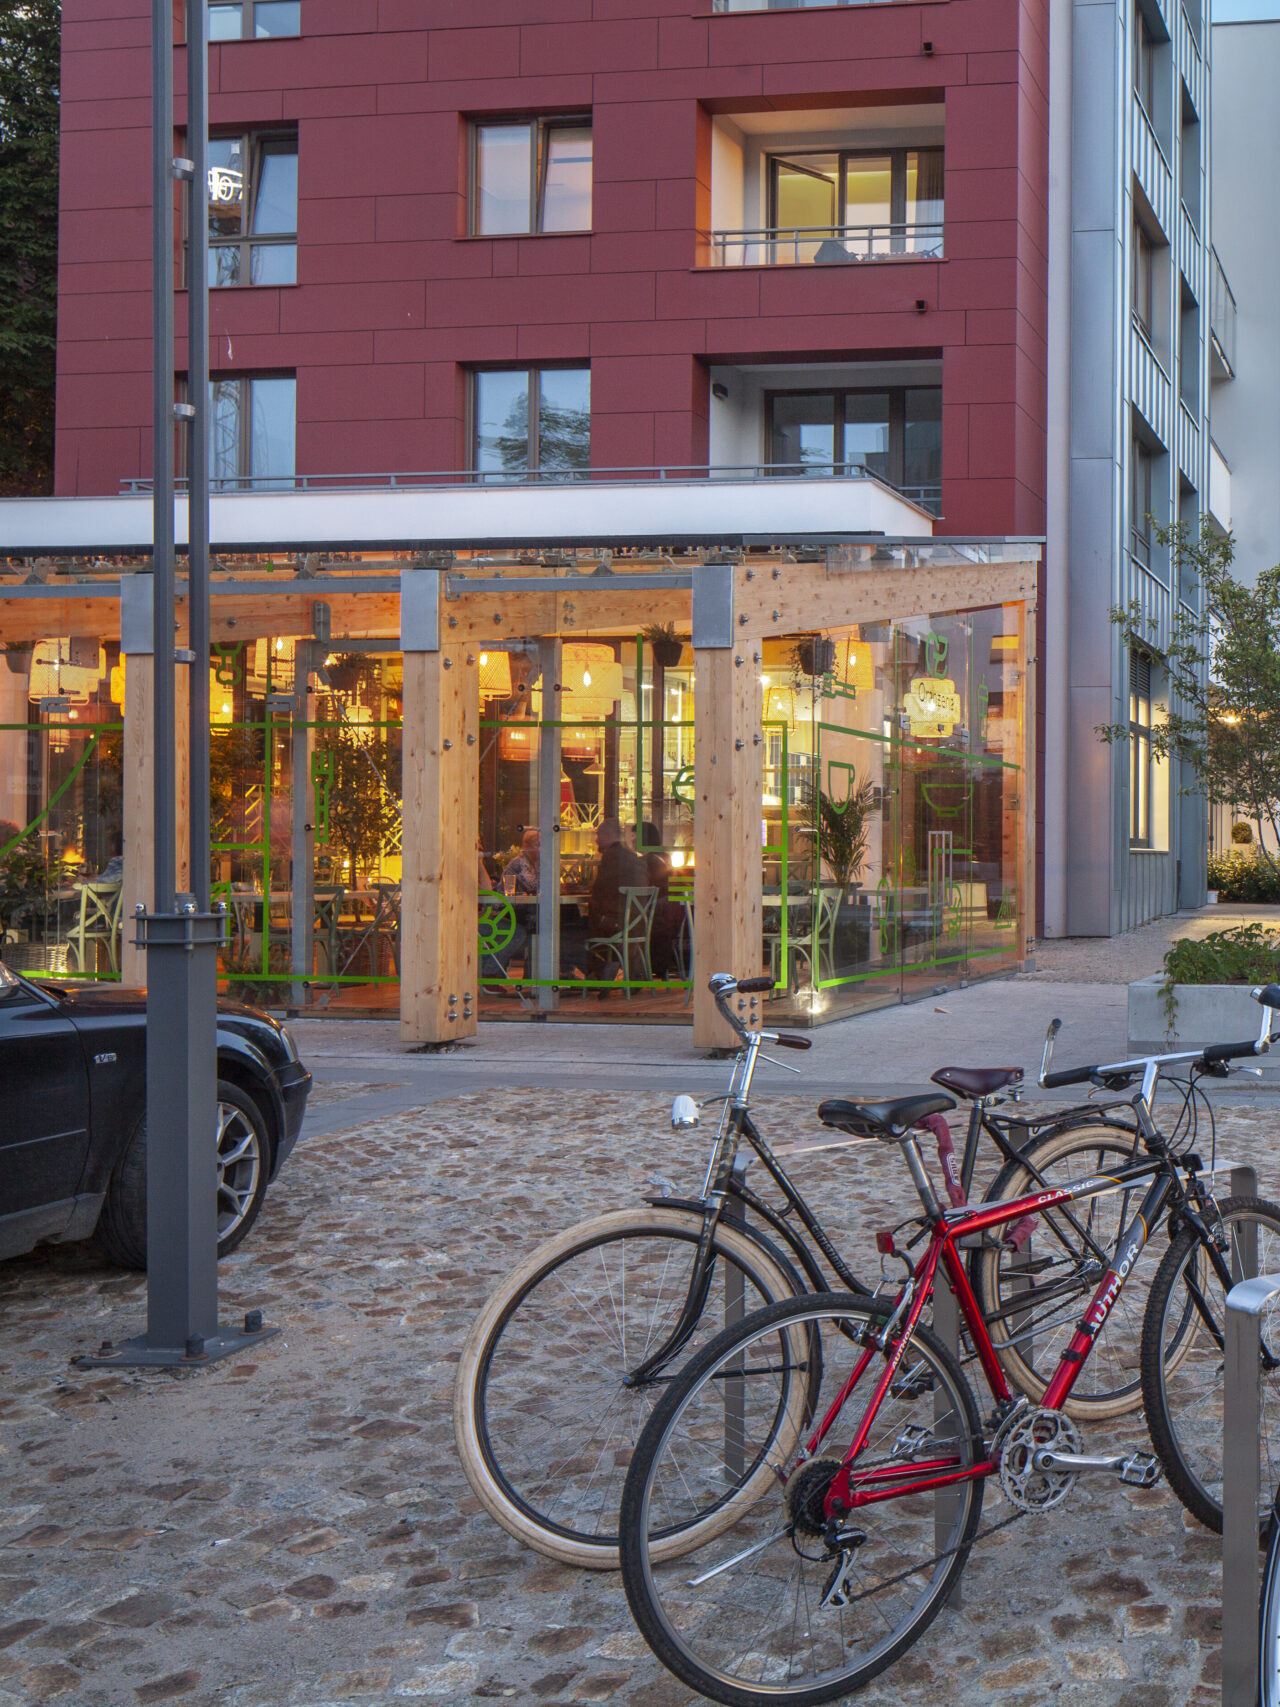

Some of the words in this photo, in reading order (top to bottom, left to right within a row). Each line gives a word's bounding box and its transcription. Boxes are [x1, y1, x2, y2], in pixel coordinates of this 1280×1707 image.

[1037, 1180, 1095, 1204] CLASSIC
[1089, 1243, 1140, 1341] AUTHOR
[892, 1323, 915, 1370] AUTHOR
